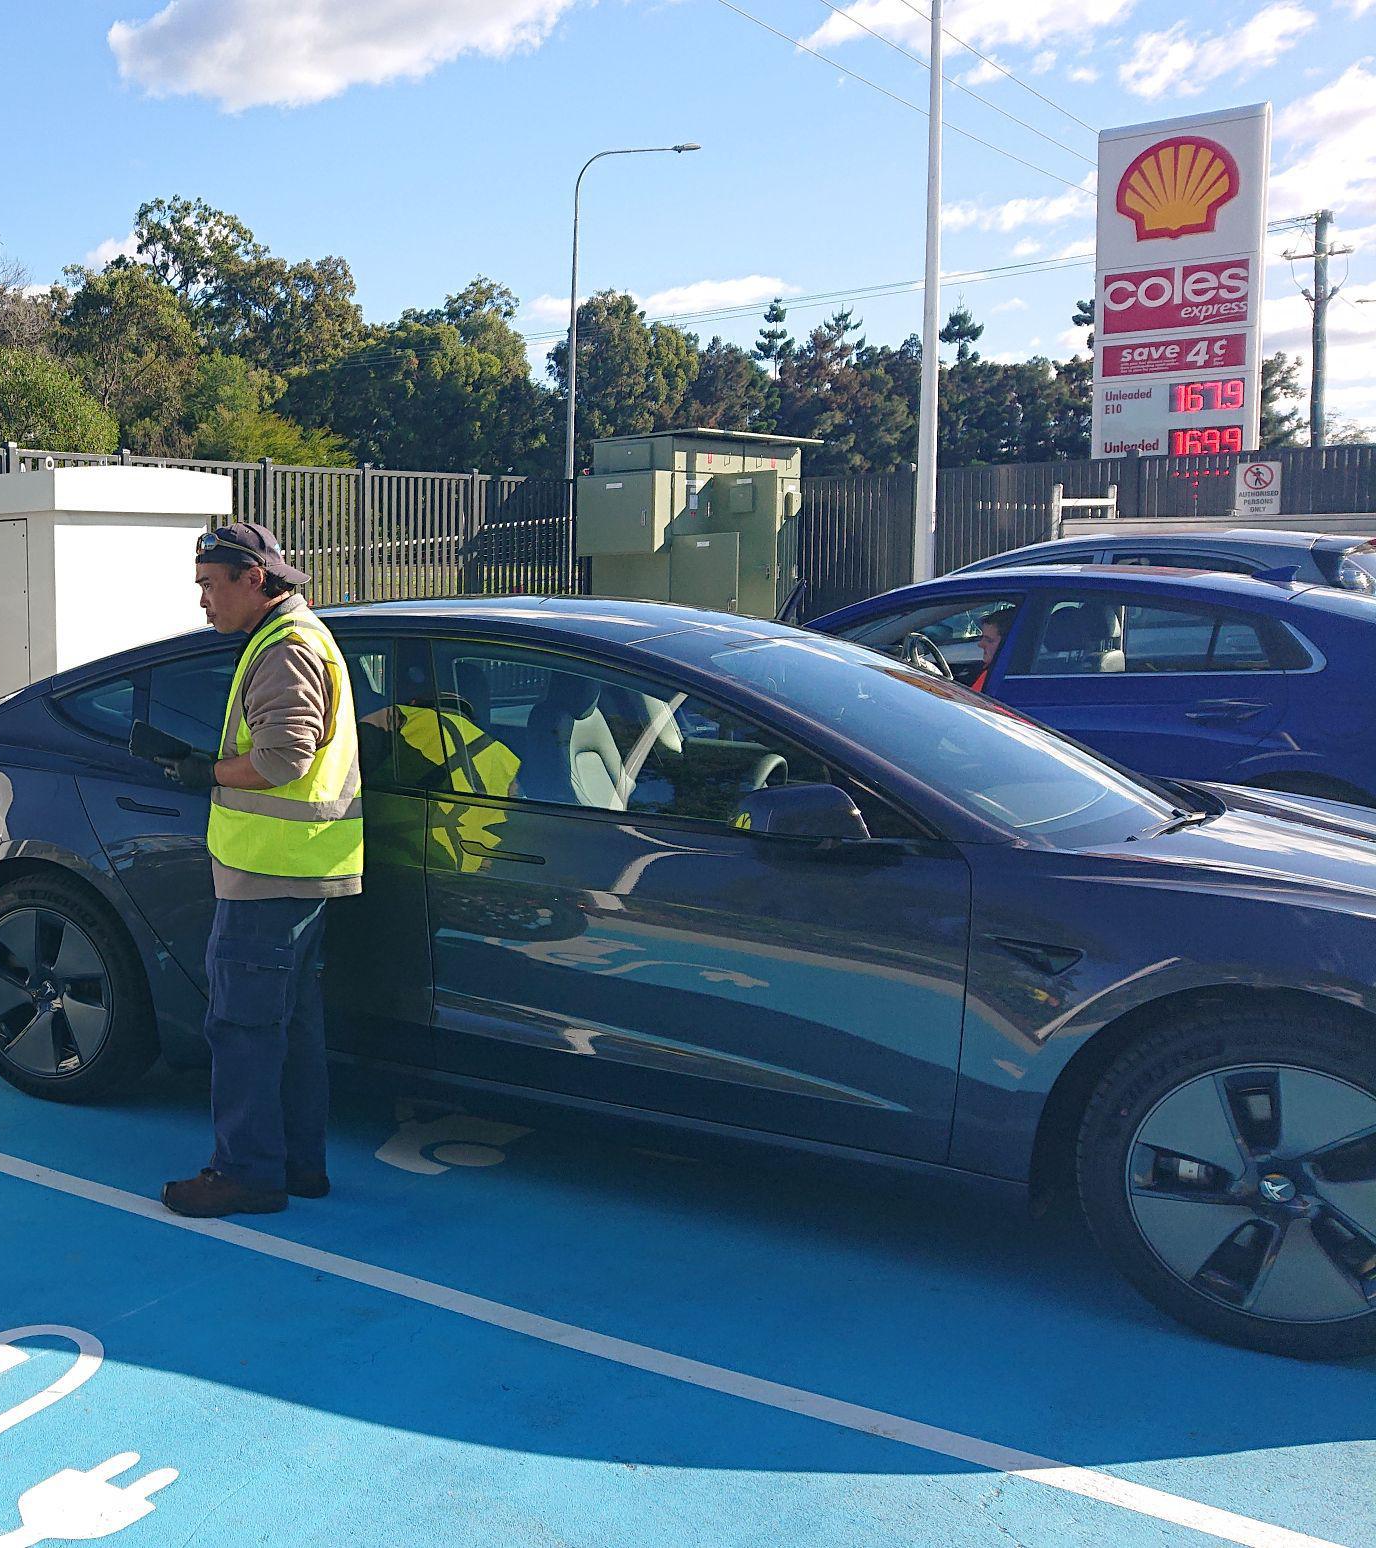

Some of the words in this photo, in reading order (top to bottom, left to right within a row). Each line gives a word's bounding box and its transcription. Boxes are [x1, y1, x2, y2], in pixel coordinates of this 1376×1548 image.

[1104, 265, 1248, 311] coles
[1180, 301, 1248, 320] express
[1121, 344, 1181, 361] save
[1105, 388, 1152, 401] Unleaded
[1105, 403, 1122, 415] E10
[1104, 438, 1160, 454] Unleaded
[1239, 490, 1279, 498] AUTHORISED
[1244, 498, 1274, 506] PERSONS
